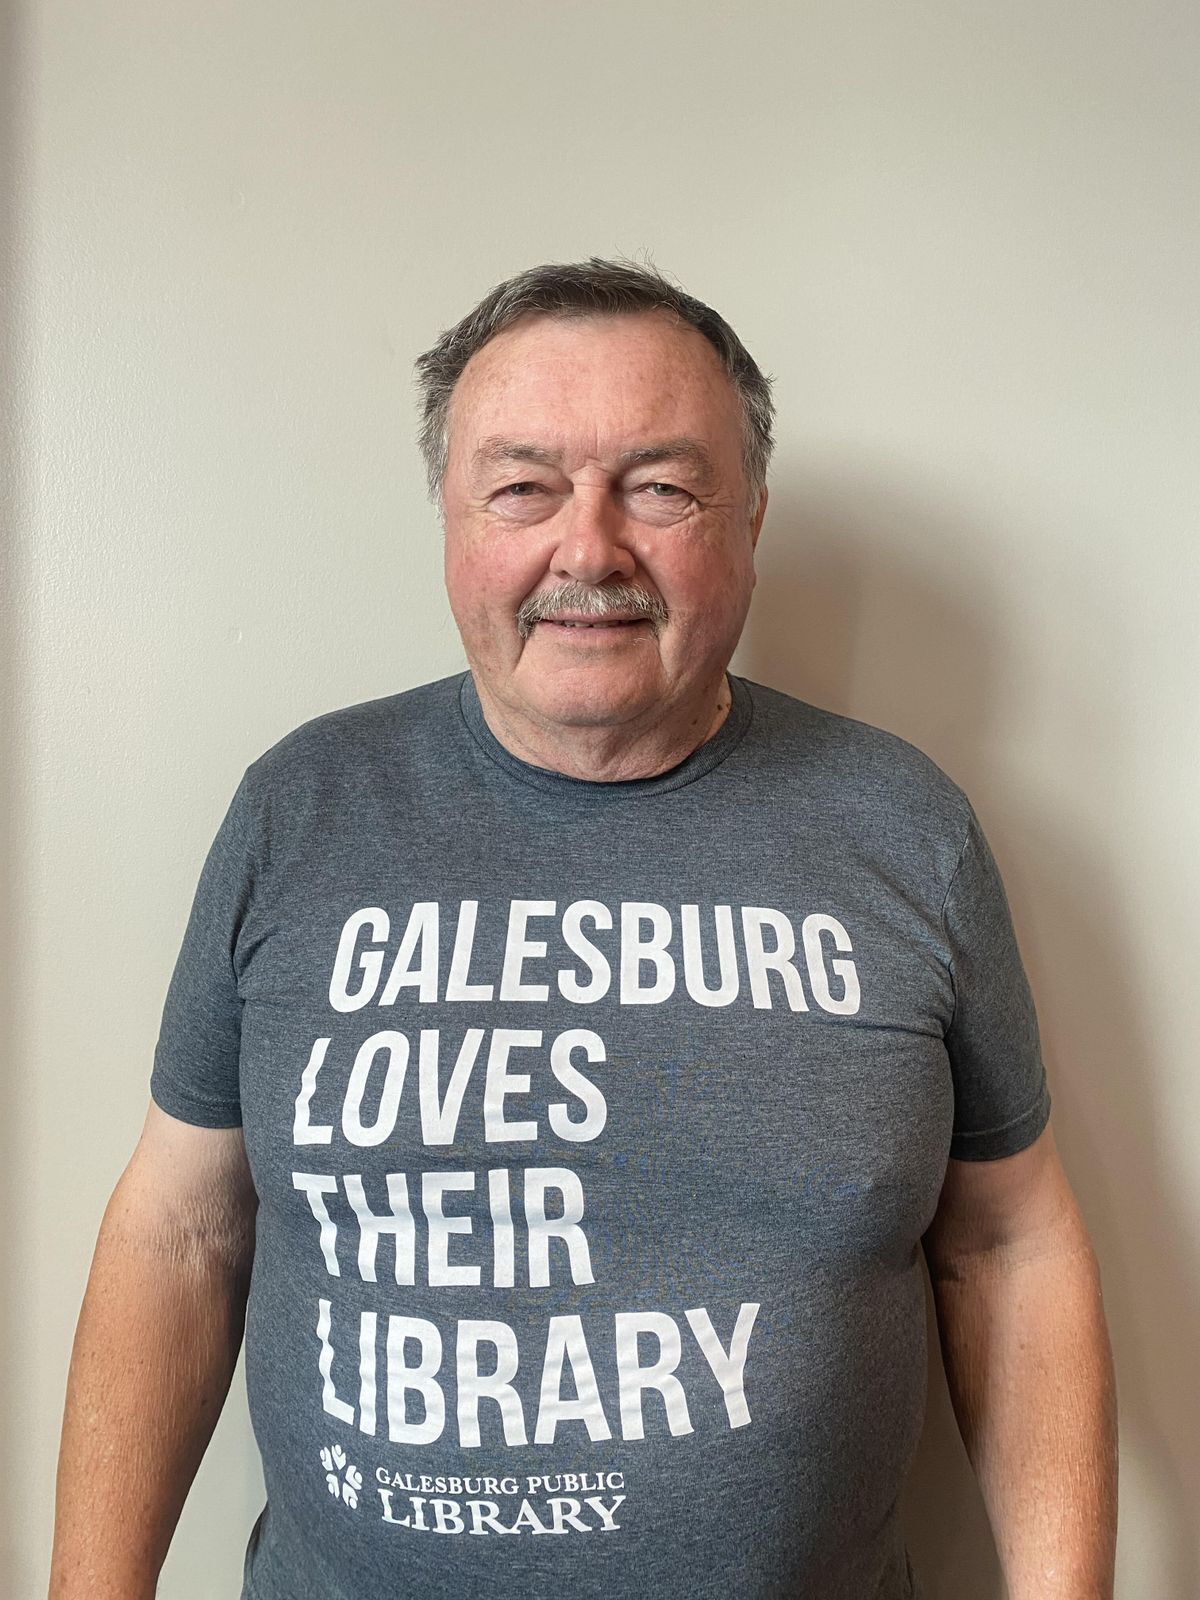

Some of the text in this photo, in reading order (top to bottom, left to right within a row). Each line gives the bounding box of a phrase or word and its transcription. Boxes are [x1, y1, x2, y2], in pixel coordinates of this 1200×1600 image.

[328, 899, 861, 1015] GALESBURG
[293, 1028, 608, 1147] LOVES
[292, 1167, 596, 1288] THEIR
[316, 1298, 761, 1449] LIBRARY
[375, 1466, 625, 1495] GALESBURG PUBLIC
[376, 1488, 627, 1536] LIBRARY
